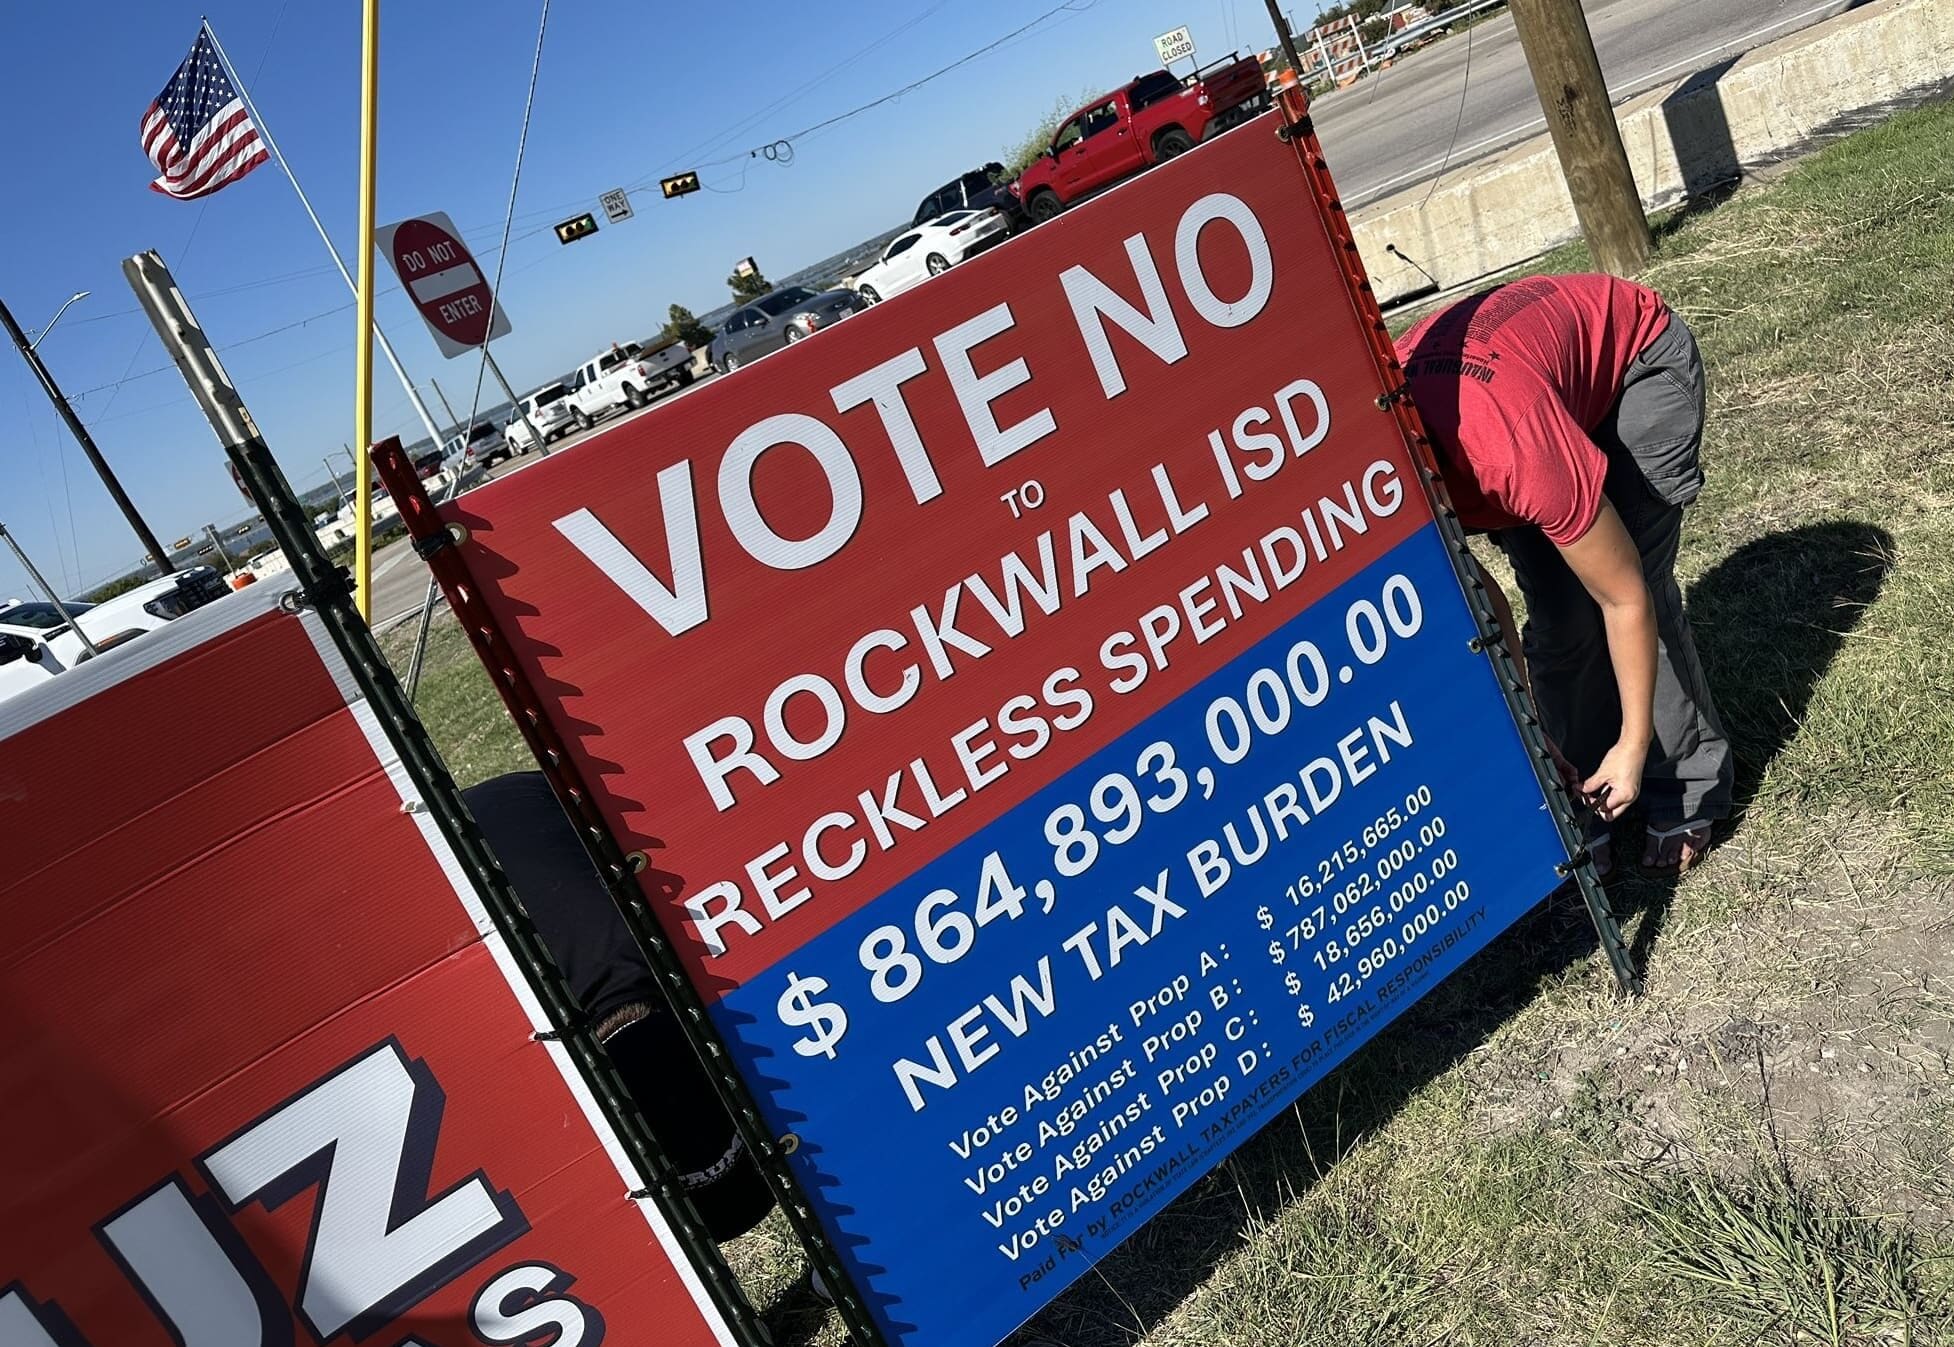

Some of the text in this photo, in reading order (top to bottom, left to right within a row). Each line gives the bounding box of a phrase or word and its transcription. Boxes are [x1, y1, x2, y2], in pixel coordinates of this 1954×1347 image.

[604, 191, 624, 204] ONE
[607, 200, 625, 212] WAY
[1161, 32, 1184, 48] ROAD
[1162, 41, 1192, 61] CLOSED
[402, 241, 457, 272] DO NOT
[439, 294, 482, 324] ENTER
[551, 192, 1274, 637] VOTE NO
[682, 378, 1331, 812] ROCKWALL ISD
[999, 479, 1045, 519] TO
[683, 459, 1404, 959] RECKLESS SPENDING
[777, 574, 1424, 1060] $ 864,893,000.00
[892, 955, 1056, 1112] NEW
[1062, 868, 1189, 981] TAX
[1186, 700, 1414, 899] BURDEN
[948, 1106, 1018, 1159] Vote
[1024, 1023, 1123, 1112] Against
[1129, 974, 1189, 1027] Prop
[1256, 905, 1275, 931] $
[1285, 784, 1433, 906] 16,215,665.00
[964, 1142, 1033, 1195] Vote
[1038, 1059, 1137, 1148] Against
[1142, 1010, 1202, 1063] Prop
[1268, 939, 1286, 965] $
[1285, 816, 1446, 950] 787,062,000.00
[981, 1175, 1049, 1228] Vote
[1055, 1092, 1152, 1181] Against
[1157, 1043, 1217, 1096] Prop
[1284, 971, 1302, 996] $
[1313, 848, 1458, 971] 18,656,000.00
[998, 1208, 1065, 1261] Vote
[1070, 1125, 1166, 1214] Against
[1171, 1075, 1230, 1128] Prop
[1298, 1003, 1315, 1028] $
[1327, 880, 1470, 1004] 42,960,000.00
[1018, 1255, 1056, 1291] Paid
[1087, 1215, 1107, 1237] by
[1109, 1143, 1200, 1218] ROCKWALL
[1200, 1066, 1290, 1143] TAXPAYERS
[1291, 1040, 1323, 1072] FOR
[1323, 998, 1376, 1043] FISCAL
[1376, 905, 1487, 1000] RESPONSIBILITY
